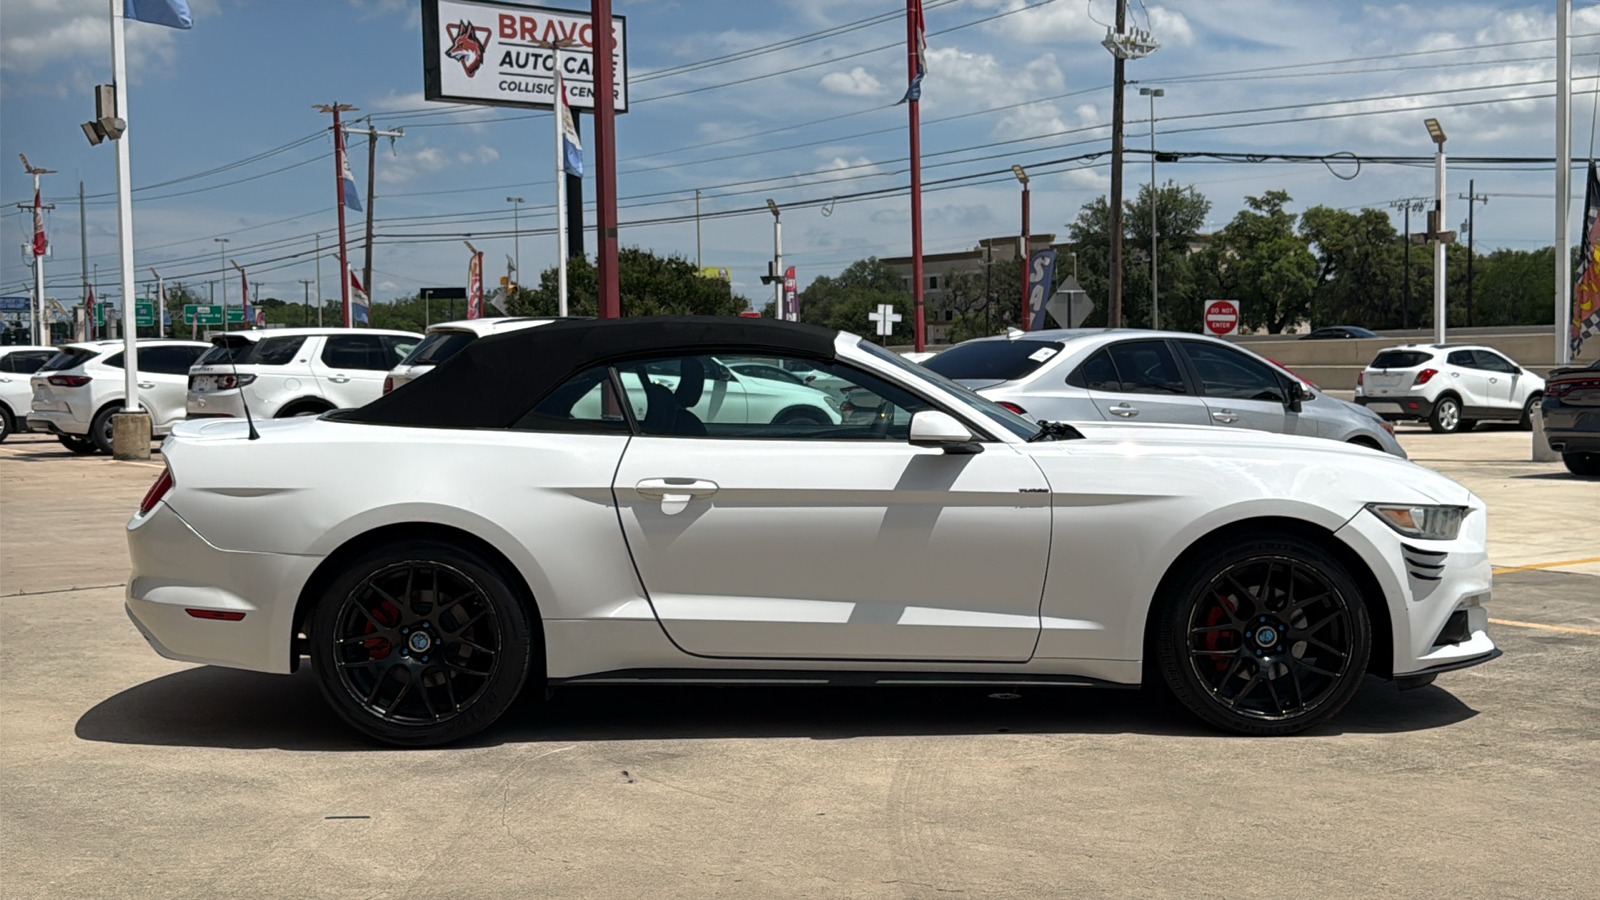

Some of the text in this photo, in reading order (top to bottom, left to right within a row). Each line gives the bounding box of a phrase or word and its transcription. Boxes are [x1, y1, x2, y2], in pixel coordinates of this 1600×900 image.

[499, 50, 555, 72] AUTO
[498, 80, 619, 100] COLLISIO CENR
